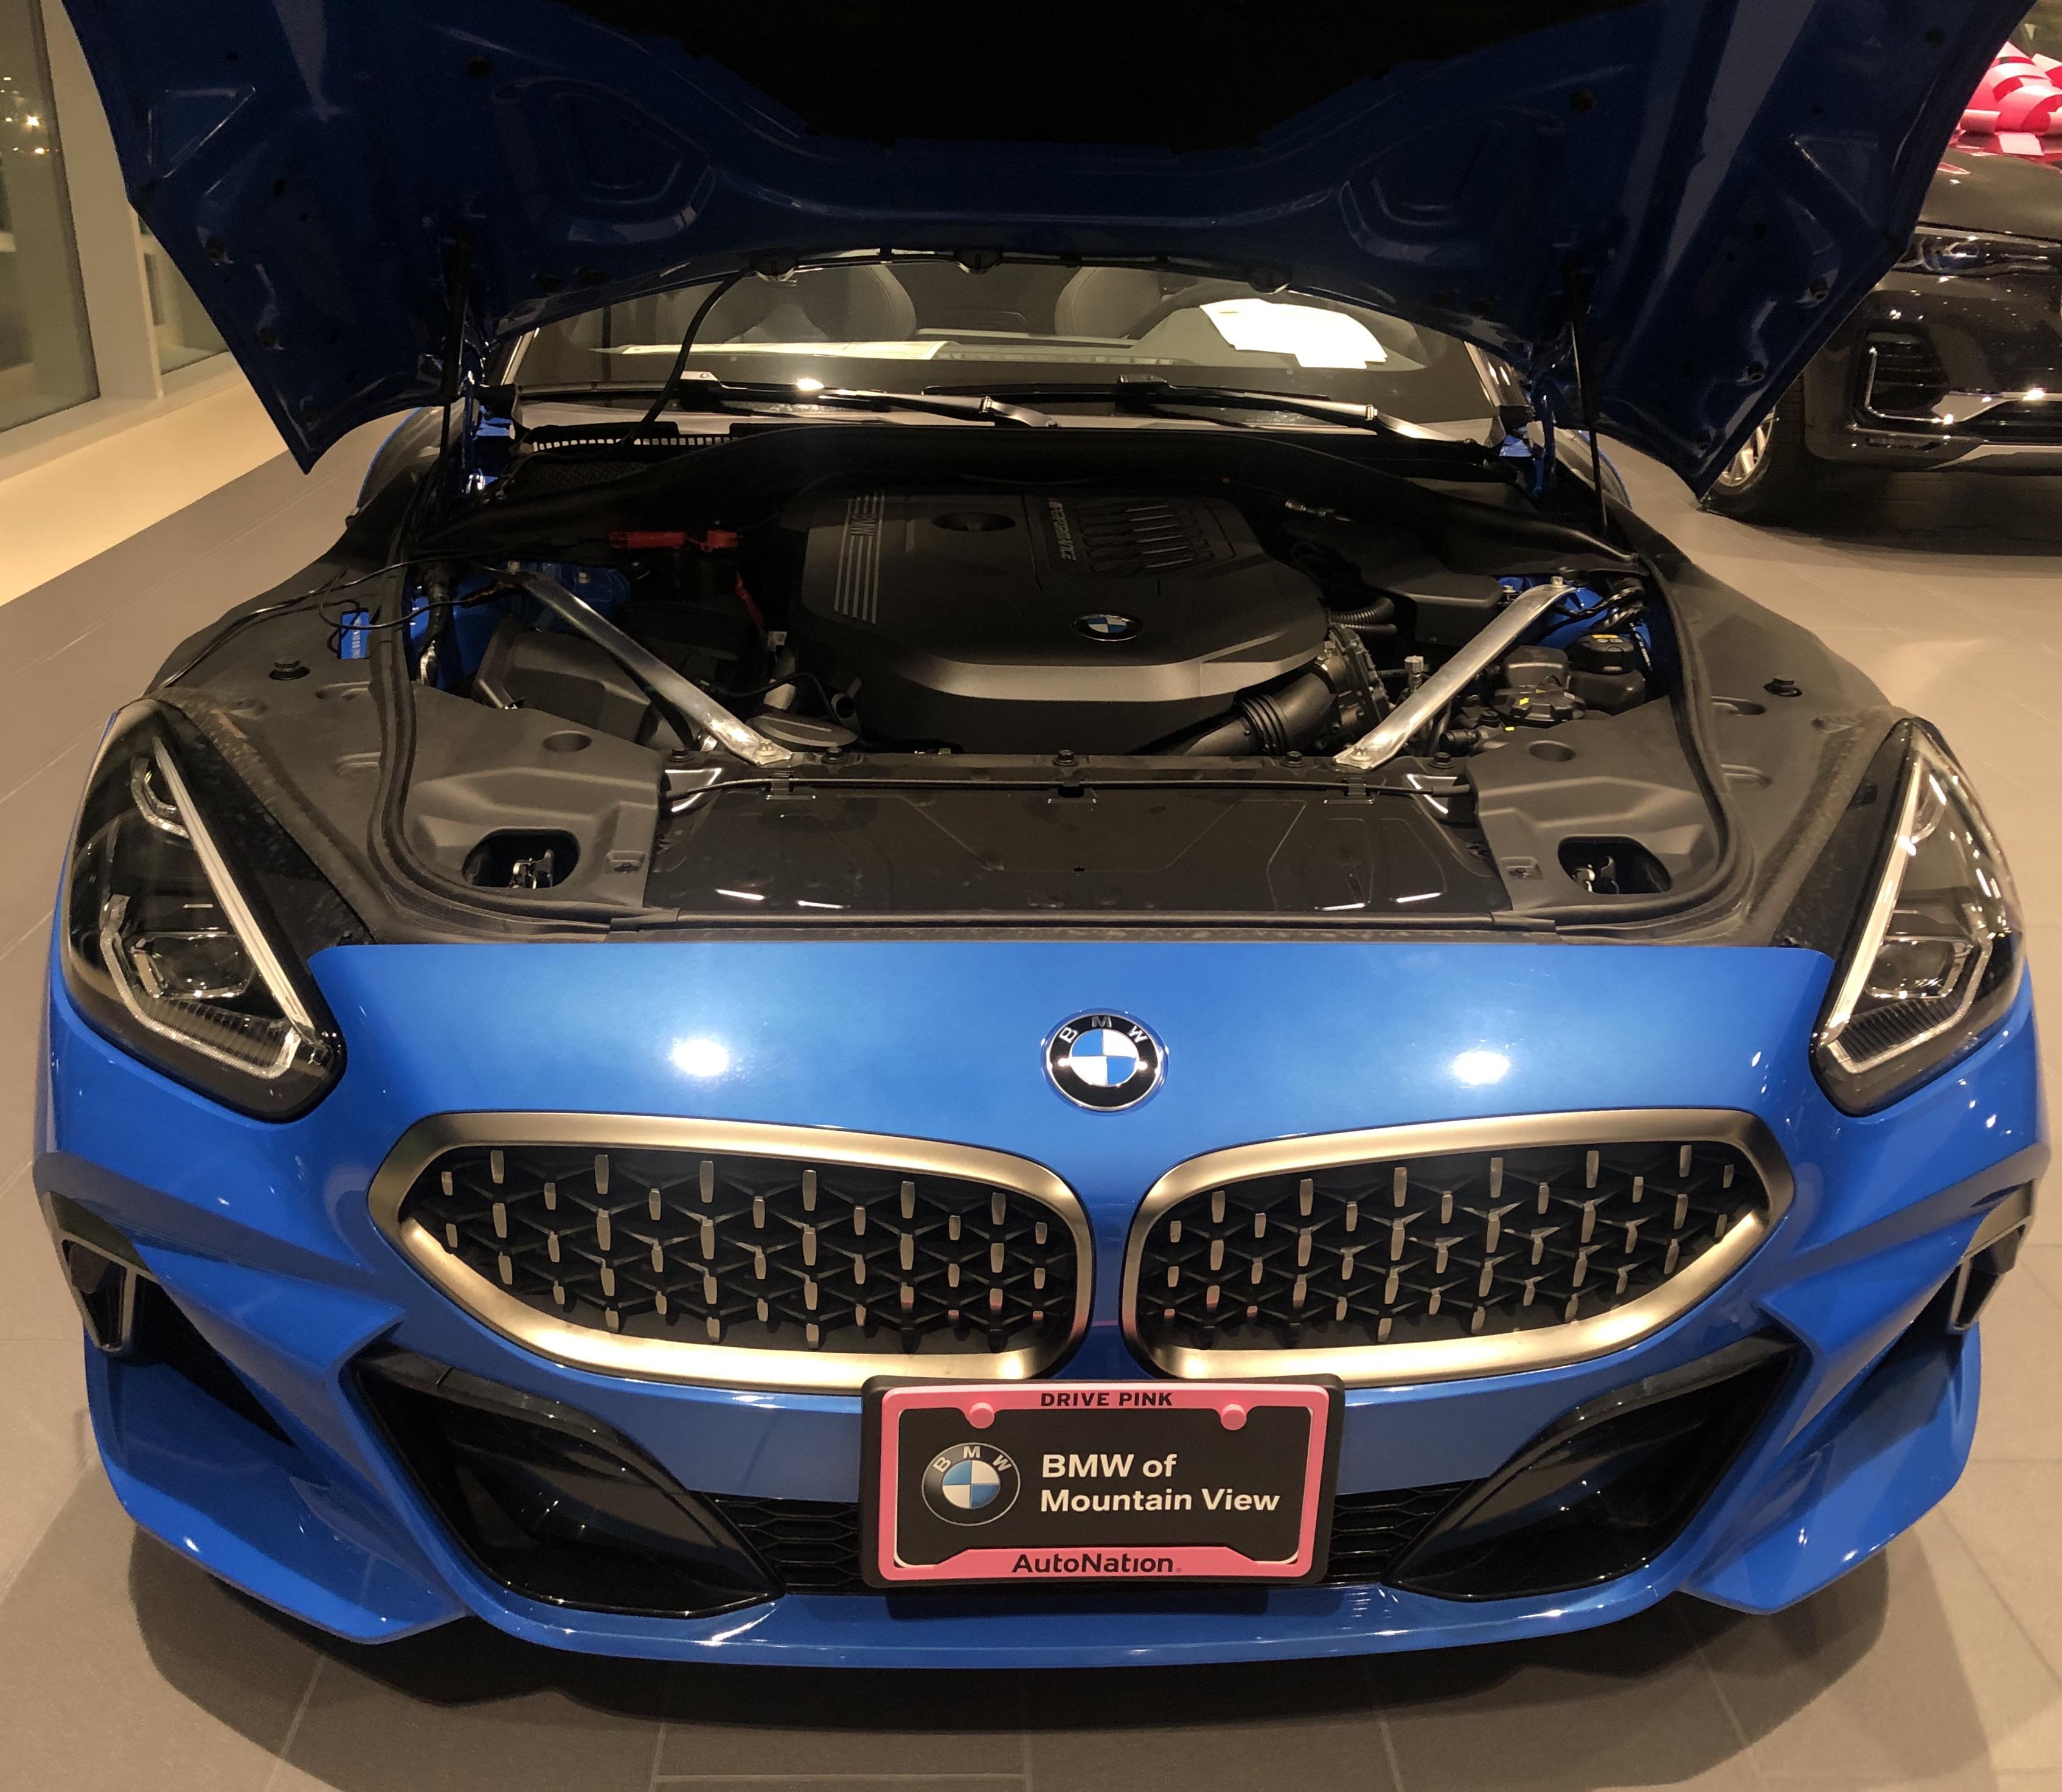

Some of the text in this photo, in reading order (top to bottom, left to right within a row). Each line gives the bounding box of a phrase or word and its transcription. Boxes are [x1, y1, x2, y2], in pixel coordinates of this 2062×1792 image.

[1058, 1015, 1148, 1044] BMW
[1041, 1392, 1173, 1406] DRIVE PINK
[933, 1446, 1012, 1473] BMW
[1043, 1454, 1178, 1478] BMW of
[1041, 1488, 1280, 1512] Mountain View
